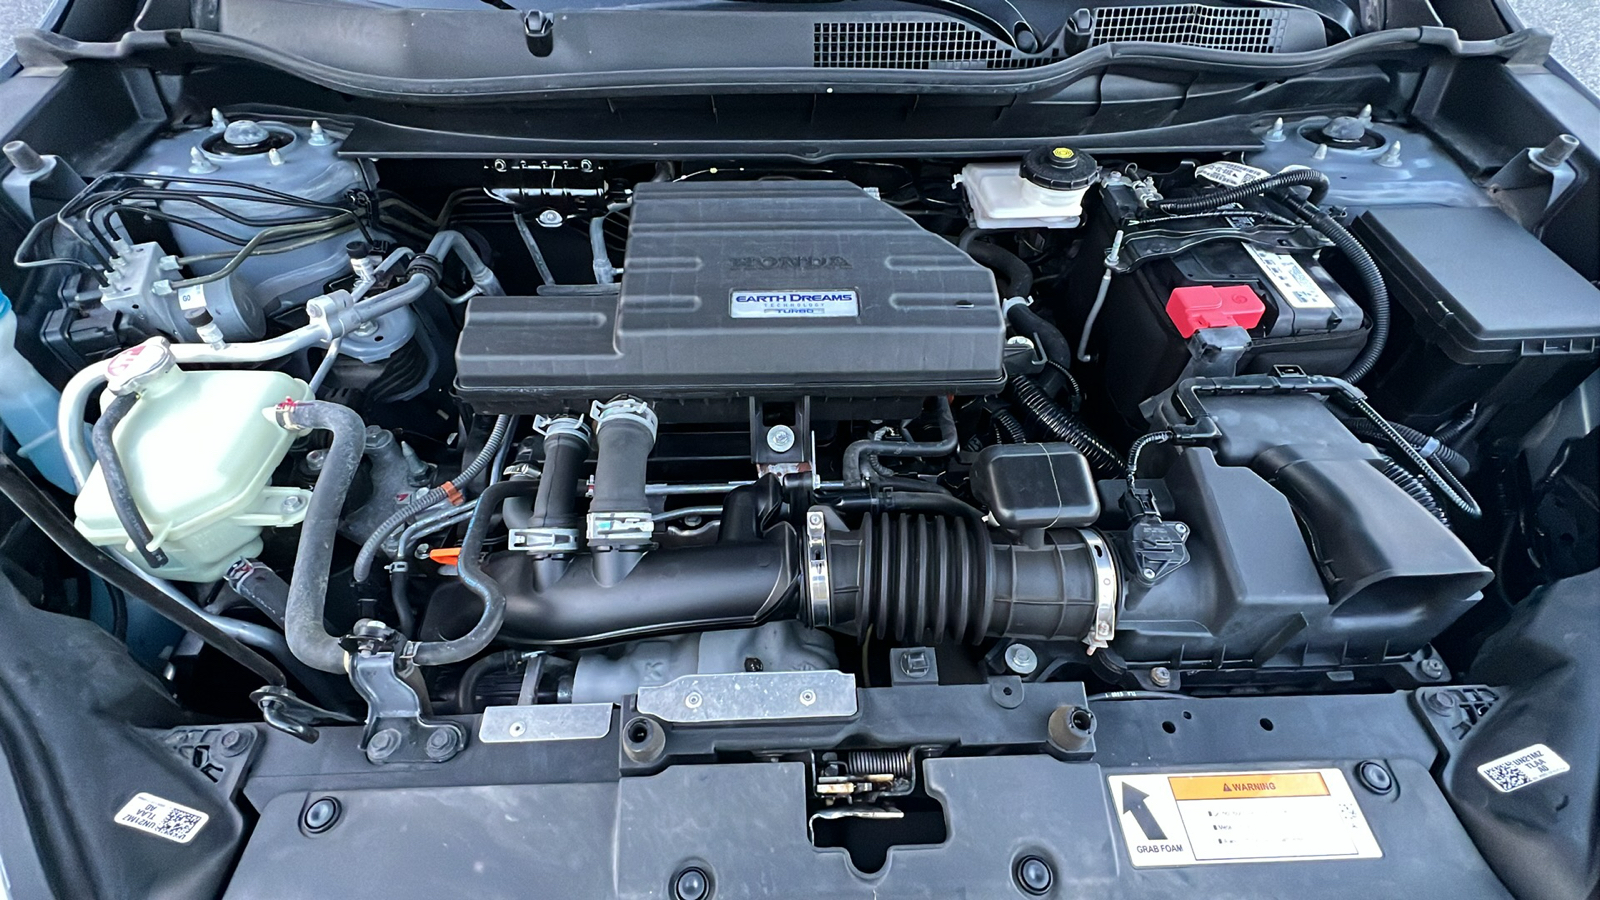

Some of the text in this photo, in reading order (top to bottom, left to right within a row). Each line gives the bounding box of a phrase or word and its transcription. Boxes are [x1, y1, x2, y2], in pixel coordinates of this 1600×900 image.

[730, 255, 853, 271] HONDA
[735, 294, 853, 303] EARTH DREAMS
[1231, 782, 1276, 791] WARNING
[1136, 844, 1183, 854] GRAB FOAM
